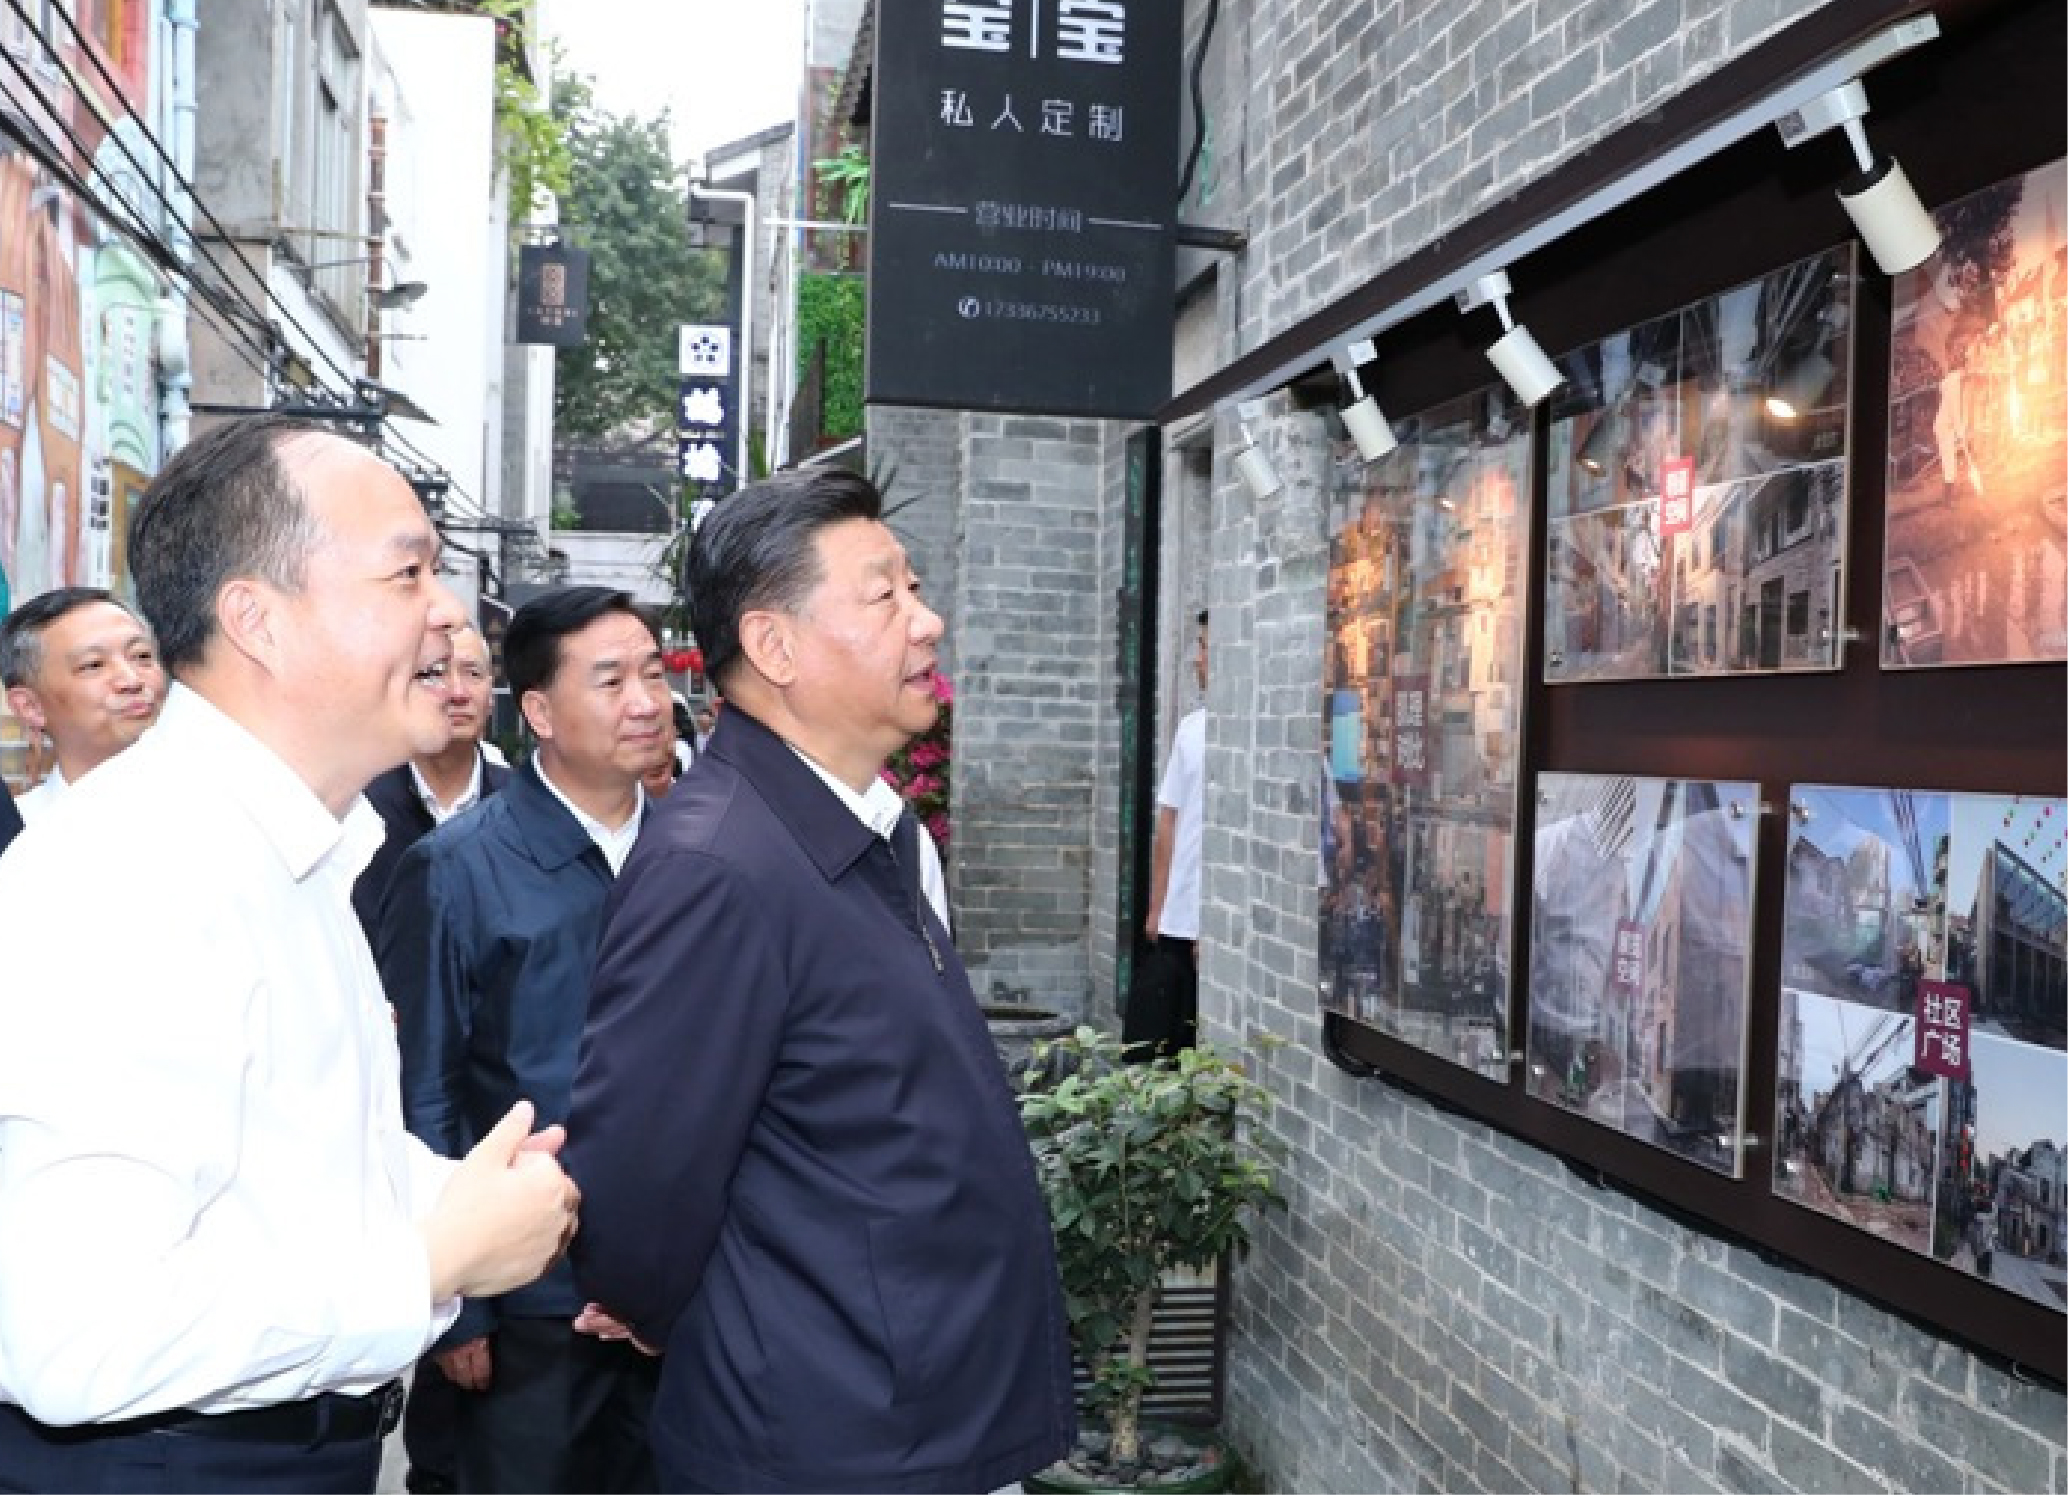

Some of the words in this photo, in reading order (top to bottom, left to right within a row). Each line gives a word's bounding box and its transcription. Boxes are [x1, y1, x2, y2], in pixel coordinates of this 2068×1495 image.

[941, 88, 1124, 141] 私人定制
[976, 200, 1081, 233] 营业时间
[1923, 992, 1963, 1029] 社区
[1921, 1029, 1961, 1066] 广场
